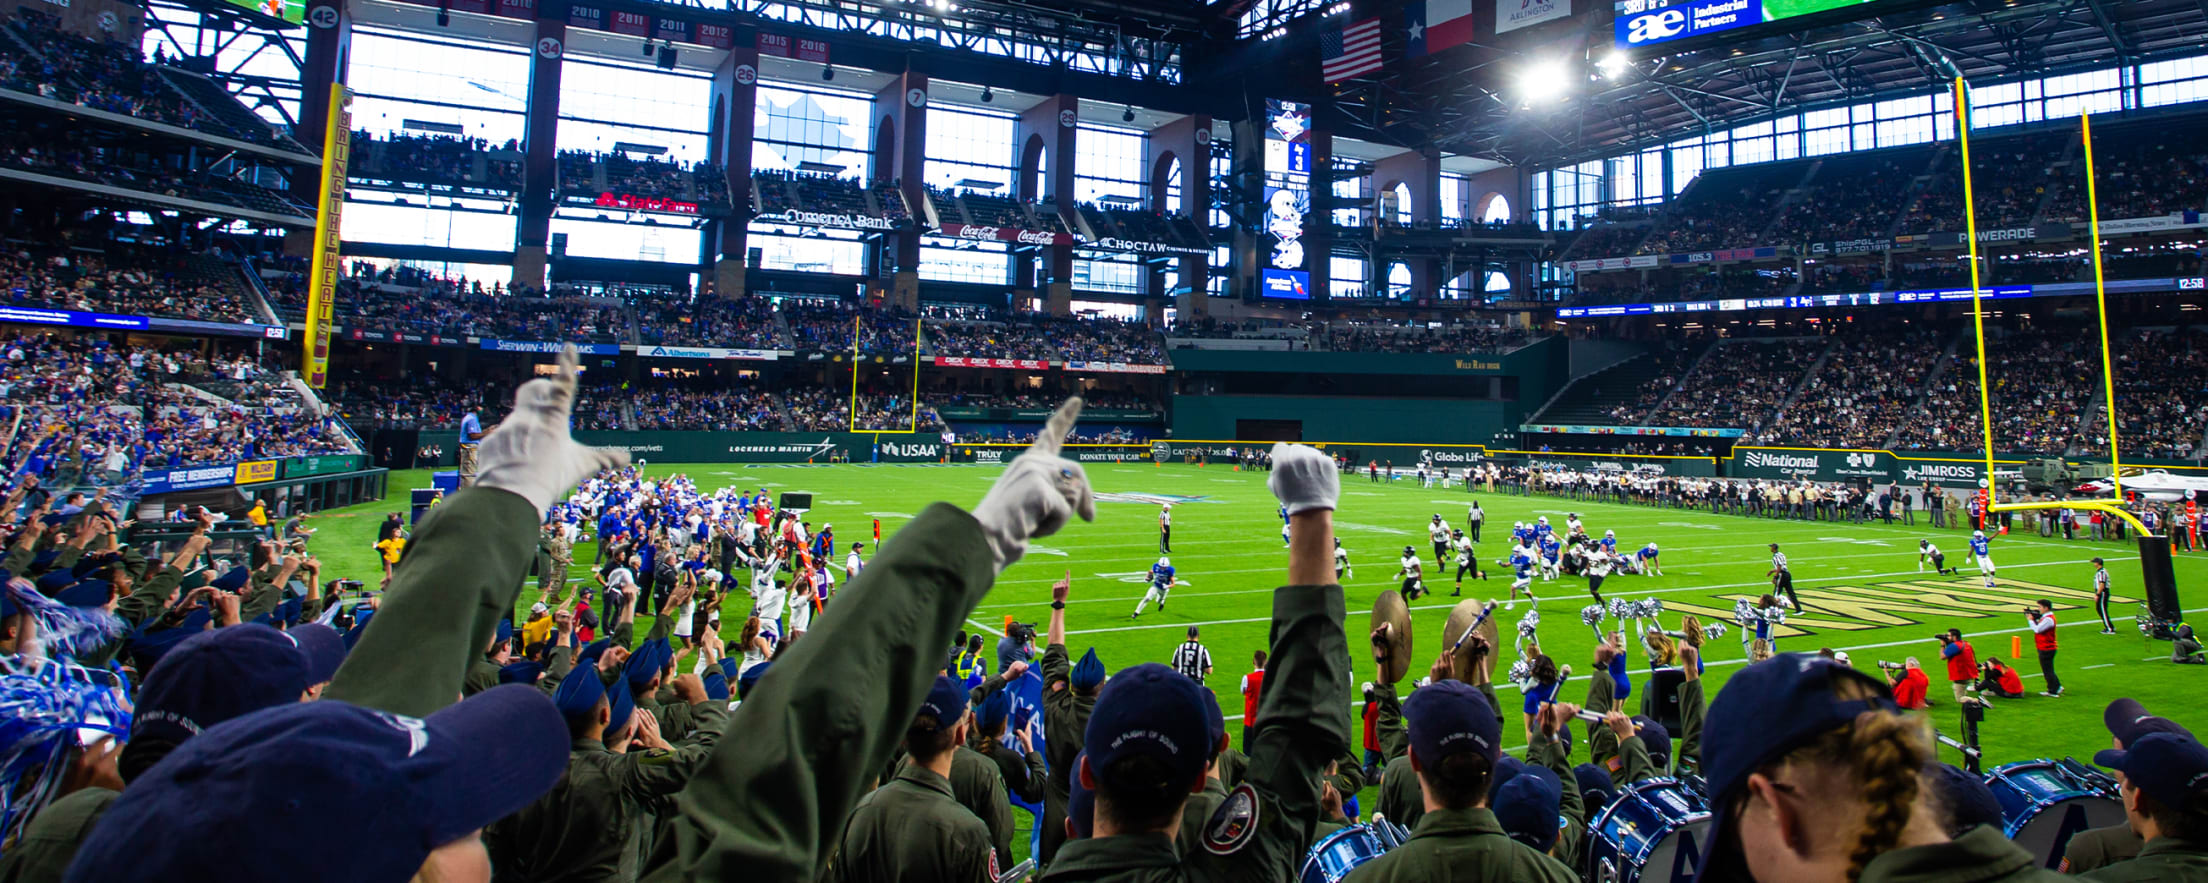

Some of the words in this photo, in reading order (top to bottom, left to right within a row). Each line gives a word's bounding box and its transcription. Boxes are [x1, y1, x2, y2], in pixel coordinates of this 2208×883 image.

[572, 6, 600, 19] 2010
[1511, 3, 1554, 21] ARLINGTON
[1695, 0, 1748, 18] Industrial
[311, 9, 334, 24] 42
[618, 12, 643, 25] 2011
[1694, 14, 1737, 30] Partners
[660, 19, 685, 31] 2011
[701, 25, 728, 38] 2012
[761, 34, 786, 46] 2015
[800, 40, 825, 52] 2016
[541, 42, 560, 54] 34
[737, 67, 754, 80] 26
[913, 92, 921, 103] 7
[1061, 113, 1075, 124] 29
[333, 112, 349, 192] BRING
[329, 199, 341, 247] THE
[856, 214, 893, 230] Bank
[1958, 228, 2036, 243] PWERADE
[1107, 238, 1167, 252] CHOCTAW
[1688, 252, 1712, 262] 105.3
[321, 252, 335, 318] HEAT
[901, 444, 937, 457] USAA
[1080, 453, 1106, 461] DONATE
[1108, 453, 1125, 461] YOUR
[1126, 453, 1140, 461] CAR
[1434, 452, 1463, 463] Globe
[168, 470, 187, 483] FREE
[188, 467, 234, 481] MEMBERSHIPS
[1184, 650, 1196, 666] F
